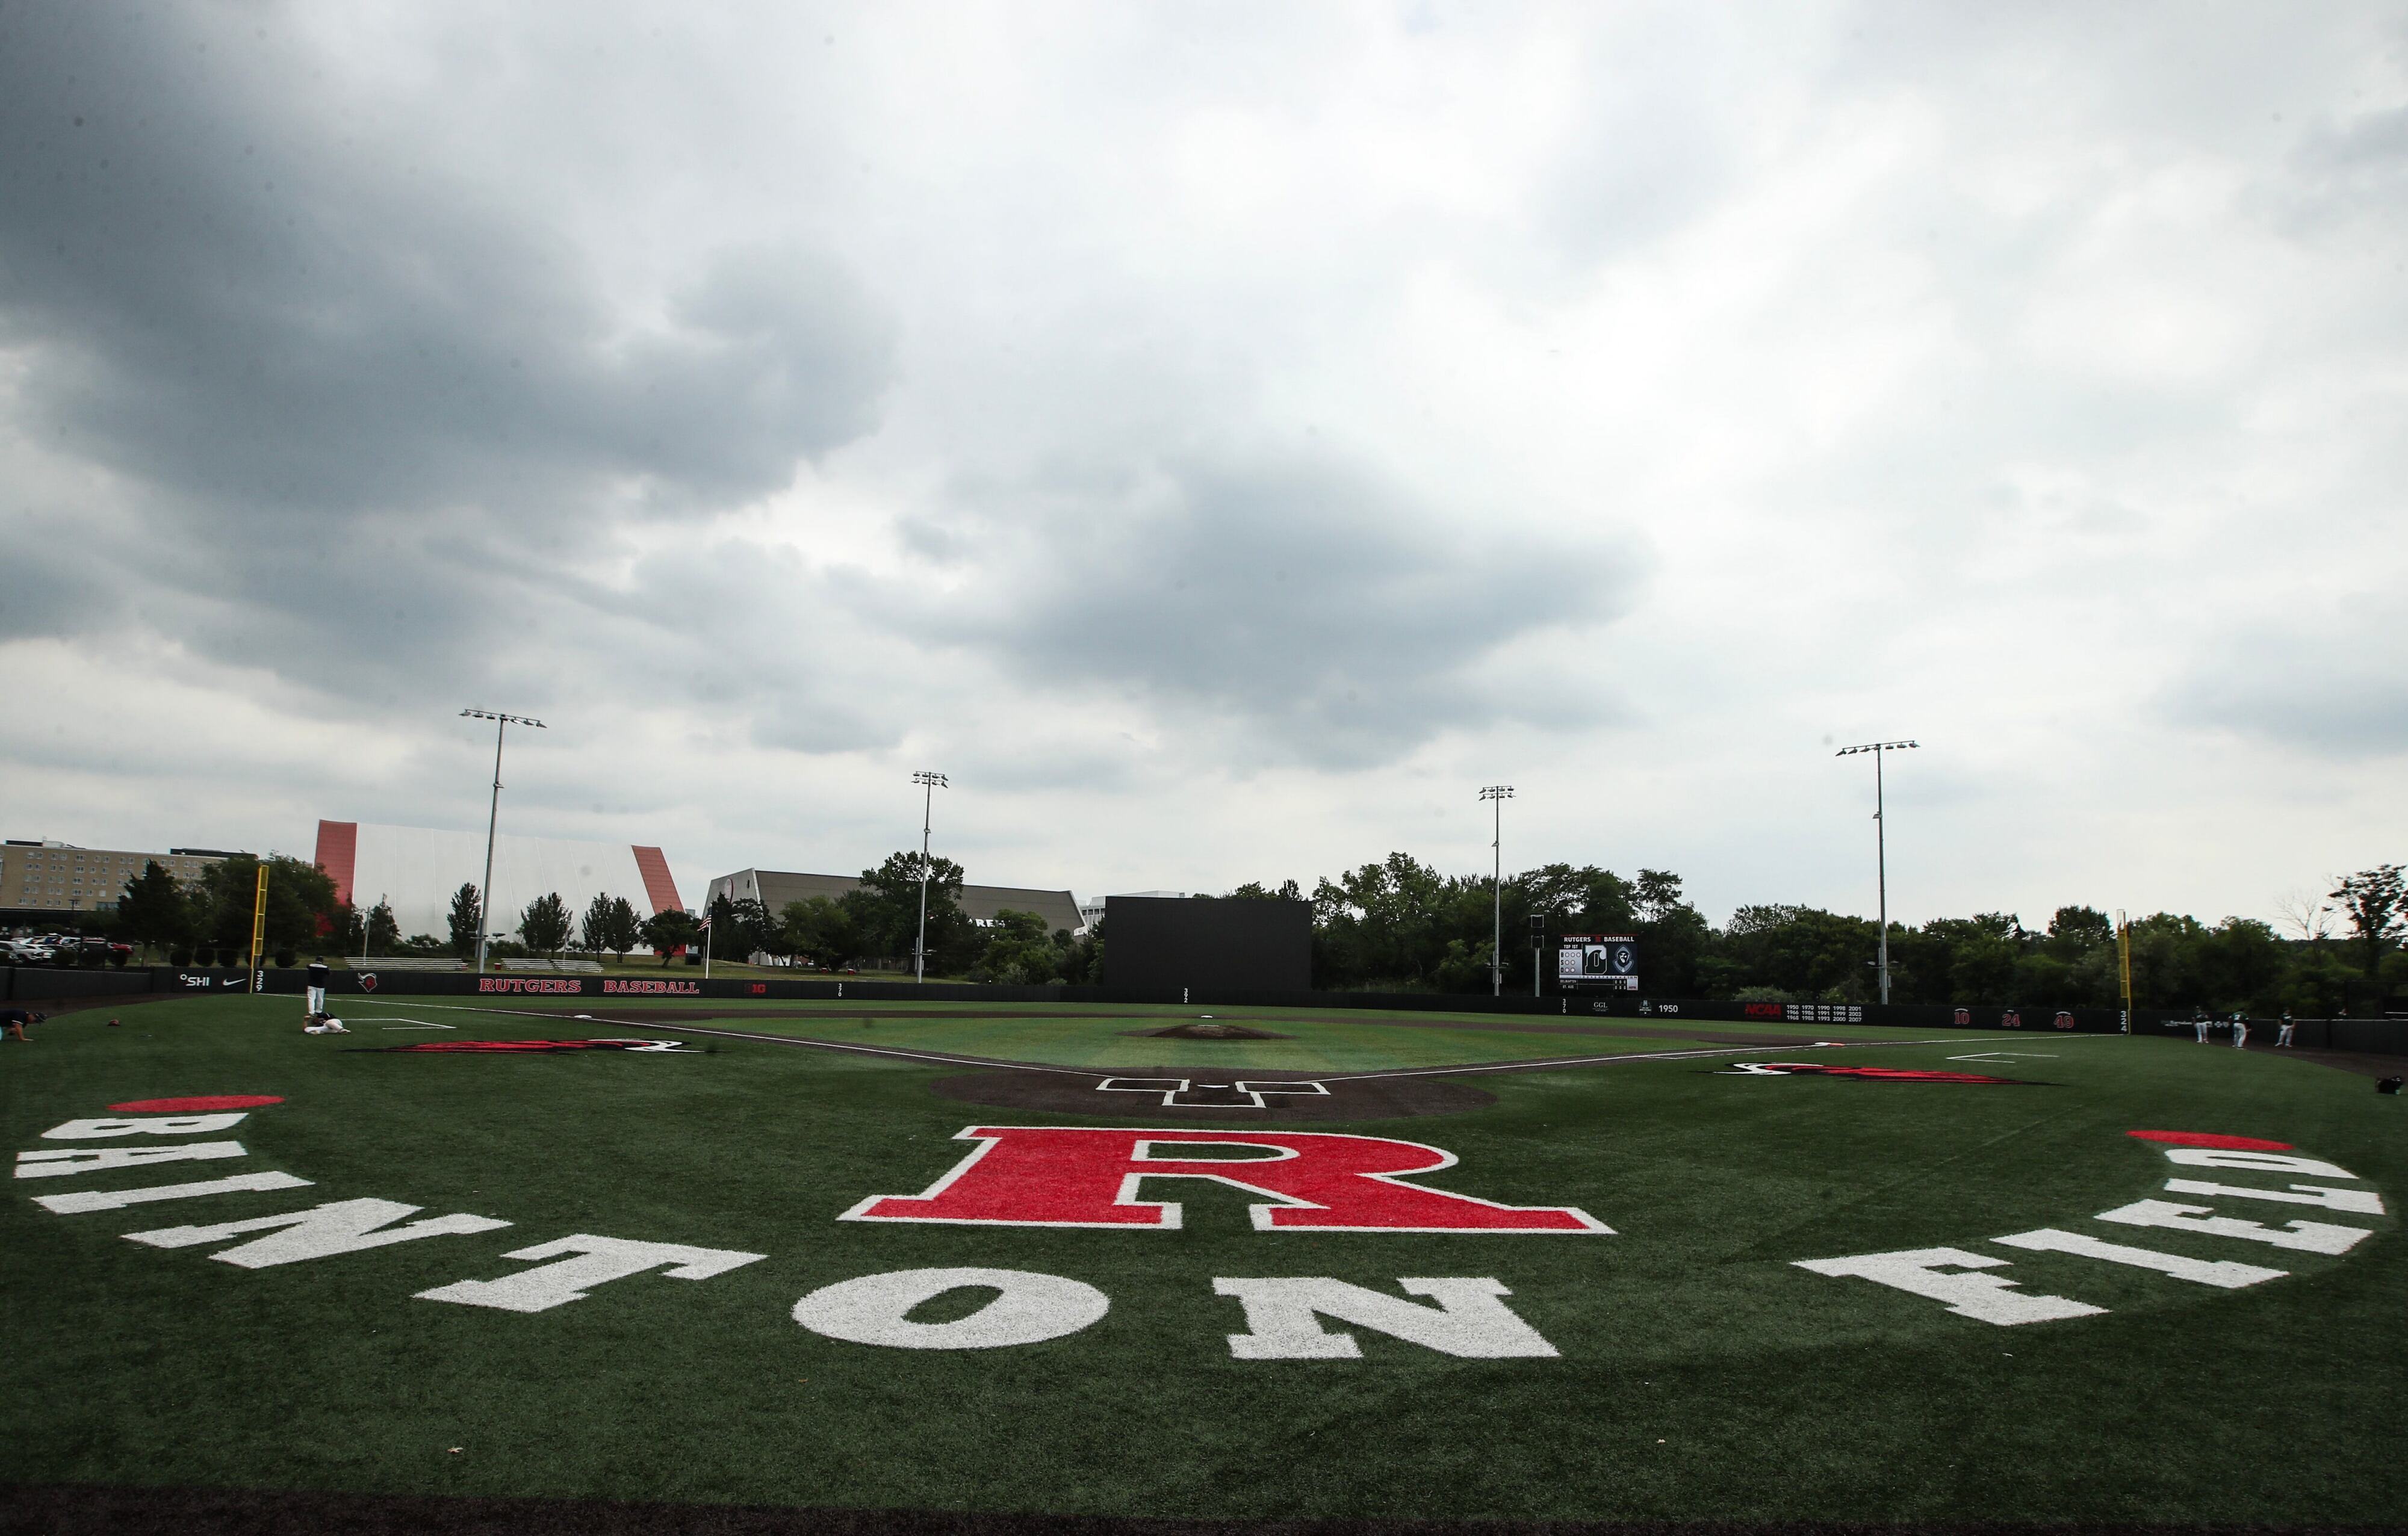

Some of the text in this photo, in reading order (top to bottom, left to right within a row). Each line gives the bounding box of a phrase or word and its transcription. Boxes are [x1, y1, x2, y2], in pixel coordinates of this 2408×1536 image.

[185, 977, 209, 986] SHI
[479, 978, 700, 994] RUTGERS BASEBALL
[1659, 1005, 1678, 1013] 1950
[1745, 1003, 1782, 1016] NCAA
[1955, 1012, 1969, 1024] 10
[2002, 1014, 2020, 1026] 24
[2054, 1015, 2074, 1028] 49
[839, 1124, 1616, 1236] R
[11, 1111, 2386, 1360] BAINTON FIELD
